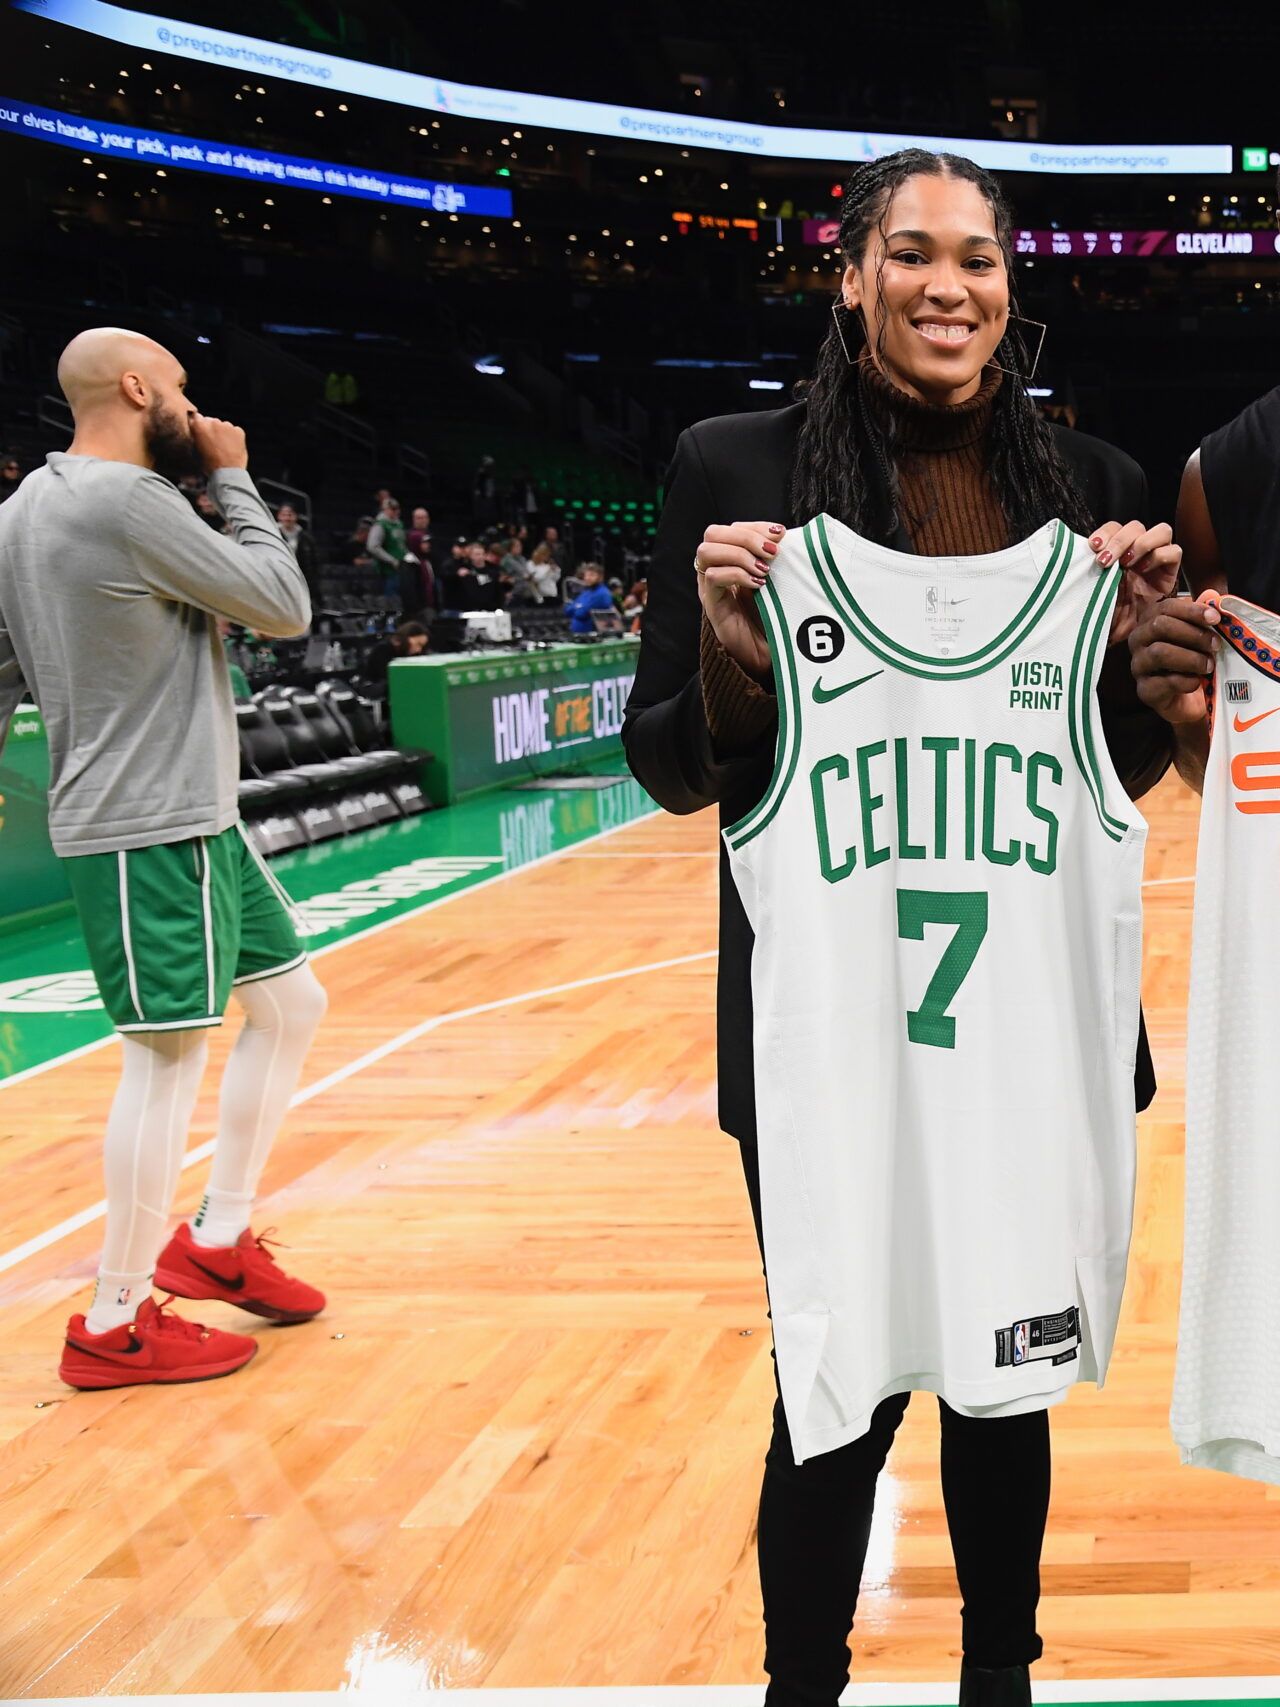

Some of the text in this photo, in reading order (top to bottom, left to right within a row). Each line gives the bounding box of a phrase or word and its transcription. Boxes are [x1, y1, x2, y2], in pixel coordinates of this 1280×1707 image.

[1175, 232, 1253, 255] CLEVELAND
[807, 622, 834, 658] 6
[1011, 661, 1063, 691] VISTA
[492, 688, 552, 764] HOME
[592, 673, 637, 739] CELT
[1009, 690, 1063, 711] PRINT
[810, 736, 1063, 884] CELTICS
[896, 888, 988, 1049] 7
